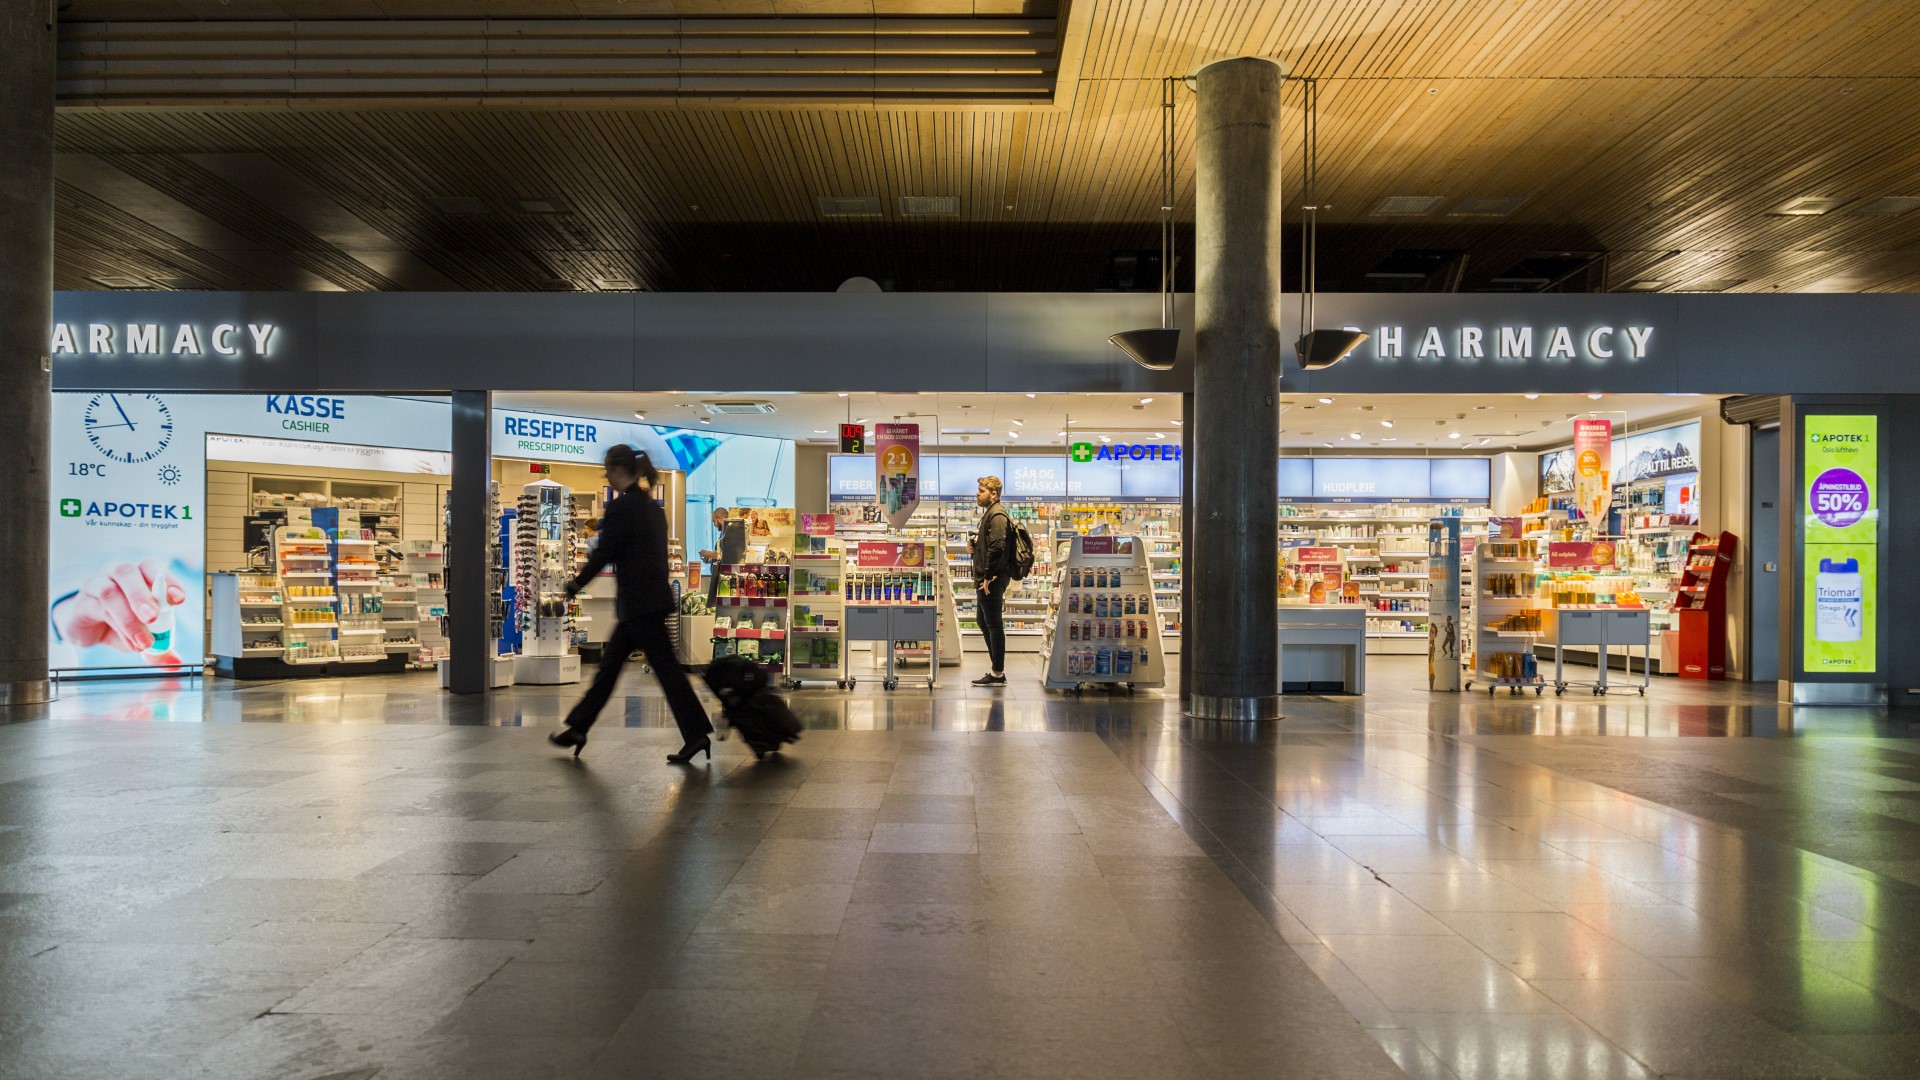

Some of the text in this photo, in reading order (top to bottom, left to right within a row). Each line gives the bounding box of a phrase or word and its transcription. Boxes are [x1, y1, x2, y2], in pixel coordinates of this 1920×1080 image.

[52, 324, 273, 355] ARMACY
[266, 395, 345, 420] KASSE
[282, 419, 330, 433] CASHIER
[505, 416, 597, 443] RESEPTER
[1822, 434, 1870, 442] APOTEK 1
[518, 440, 585, 455] PRESCRIPTIONS
[852, 440, 860, 453] 2
[888, 452, 895, 465] 2
[901, 452, 908, 465] 1
[69, 462, 107, 477] 18°C
[1014, 467, 1054, 479] SÅR OG
[839, 480, 873, 490] FEBER
[1014, 479, 1082, 491] SMÅSKADER
[1323, 482, 1376, 493] HUDPLEIE
[1818, 482, 1862, 491] ÅPNINGSTILBUD
[1818, 493, 1863, 511] 50%
[86, 501, 193, 520] APOTEK 1
[99, 520, 132, 528] kunnskap
[151, 522, 179, 530] trygghet
[905, 549, 911, 558] 2
[1818, 587, 1857, 597] Triomar
[1818, 604, 1847, 612] Omega-3
